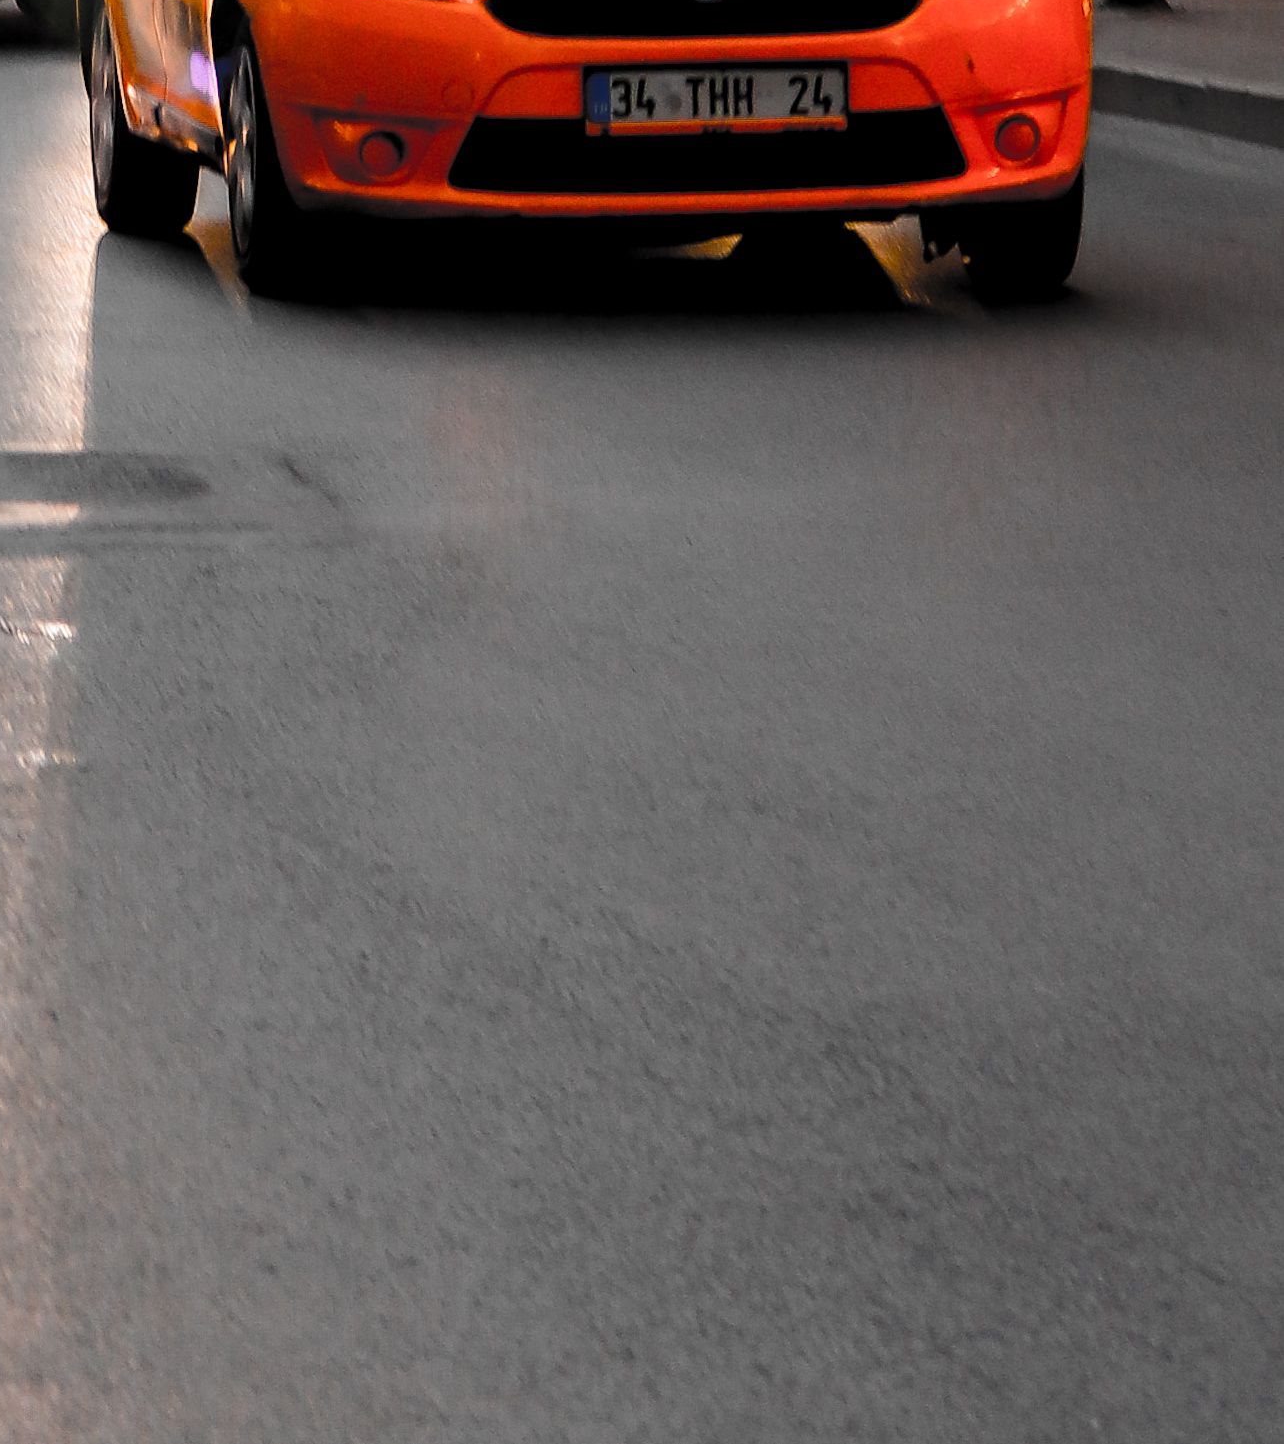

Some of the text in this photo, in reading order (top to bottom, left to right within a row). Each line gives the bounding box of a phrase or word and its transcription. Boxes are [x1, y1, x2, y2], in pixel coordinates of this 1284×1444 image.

[611, 75, 656, 120] 34
[685, 75, 754, 117] THH
[788, 74, 833, 117] 24
